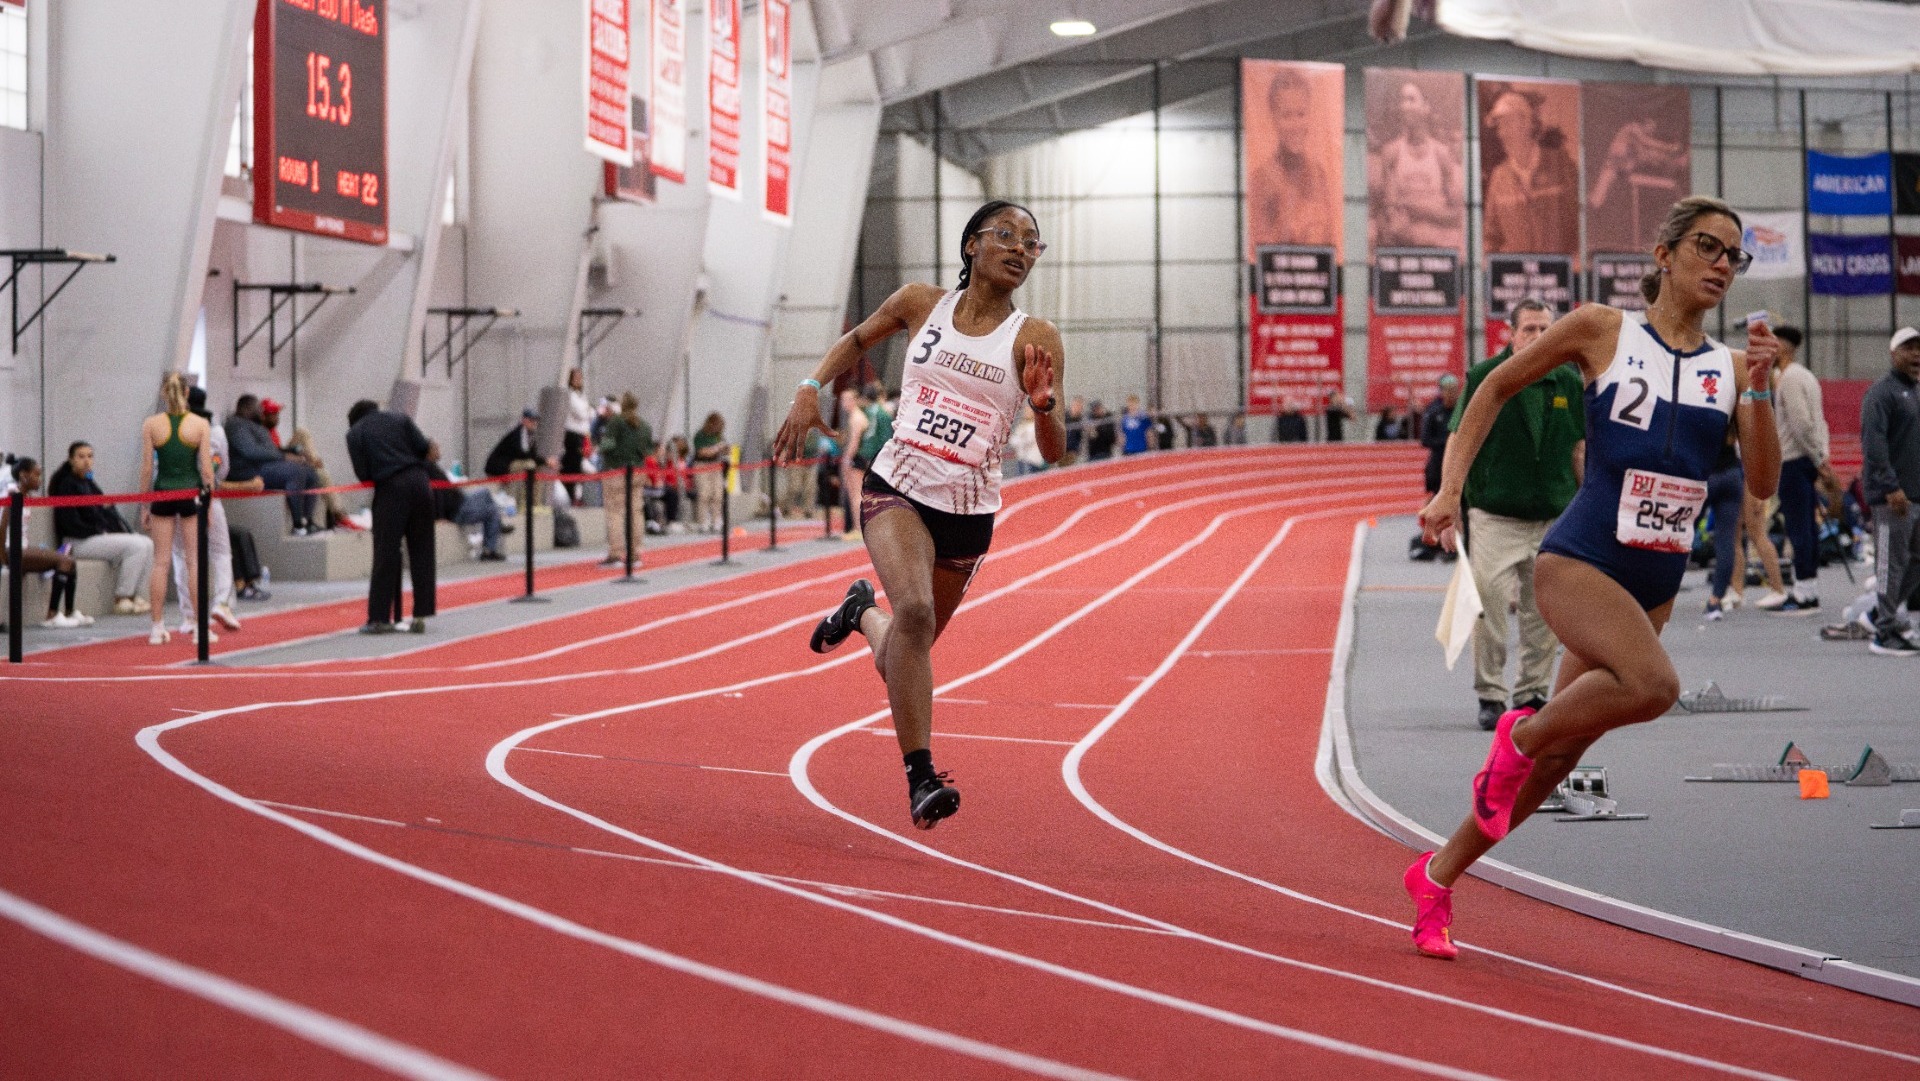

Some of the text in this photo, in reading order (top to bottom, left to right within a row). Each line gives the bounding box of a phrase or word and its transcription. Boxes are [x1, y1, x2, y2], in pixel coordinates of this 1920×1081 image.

[306, 51, 352, 127] 15.3
[278, 156, 320, 193] ROUND 1
[337, 170, 379, 207] HEAT 22
[1813, 174, 1887, 195] AMERICAN
[912, 329, 942, 364] 3
[917, 386, 940, 405] BU
[1618, 377, 1649, 425] 2
[916, 408, 977, 449] 2237
[1632, 473, 1656, 494] BU
[1636, 499, 1693, 533] 2542
